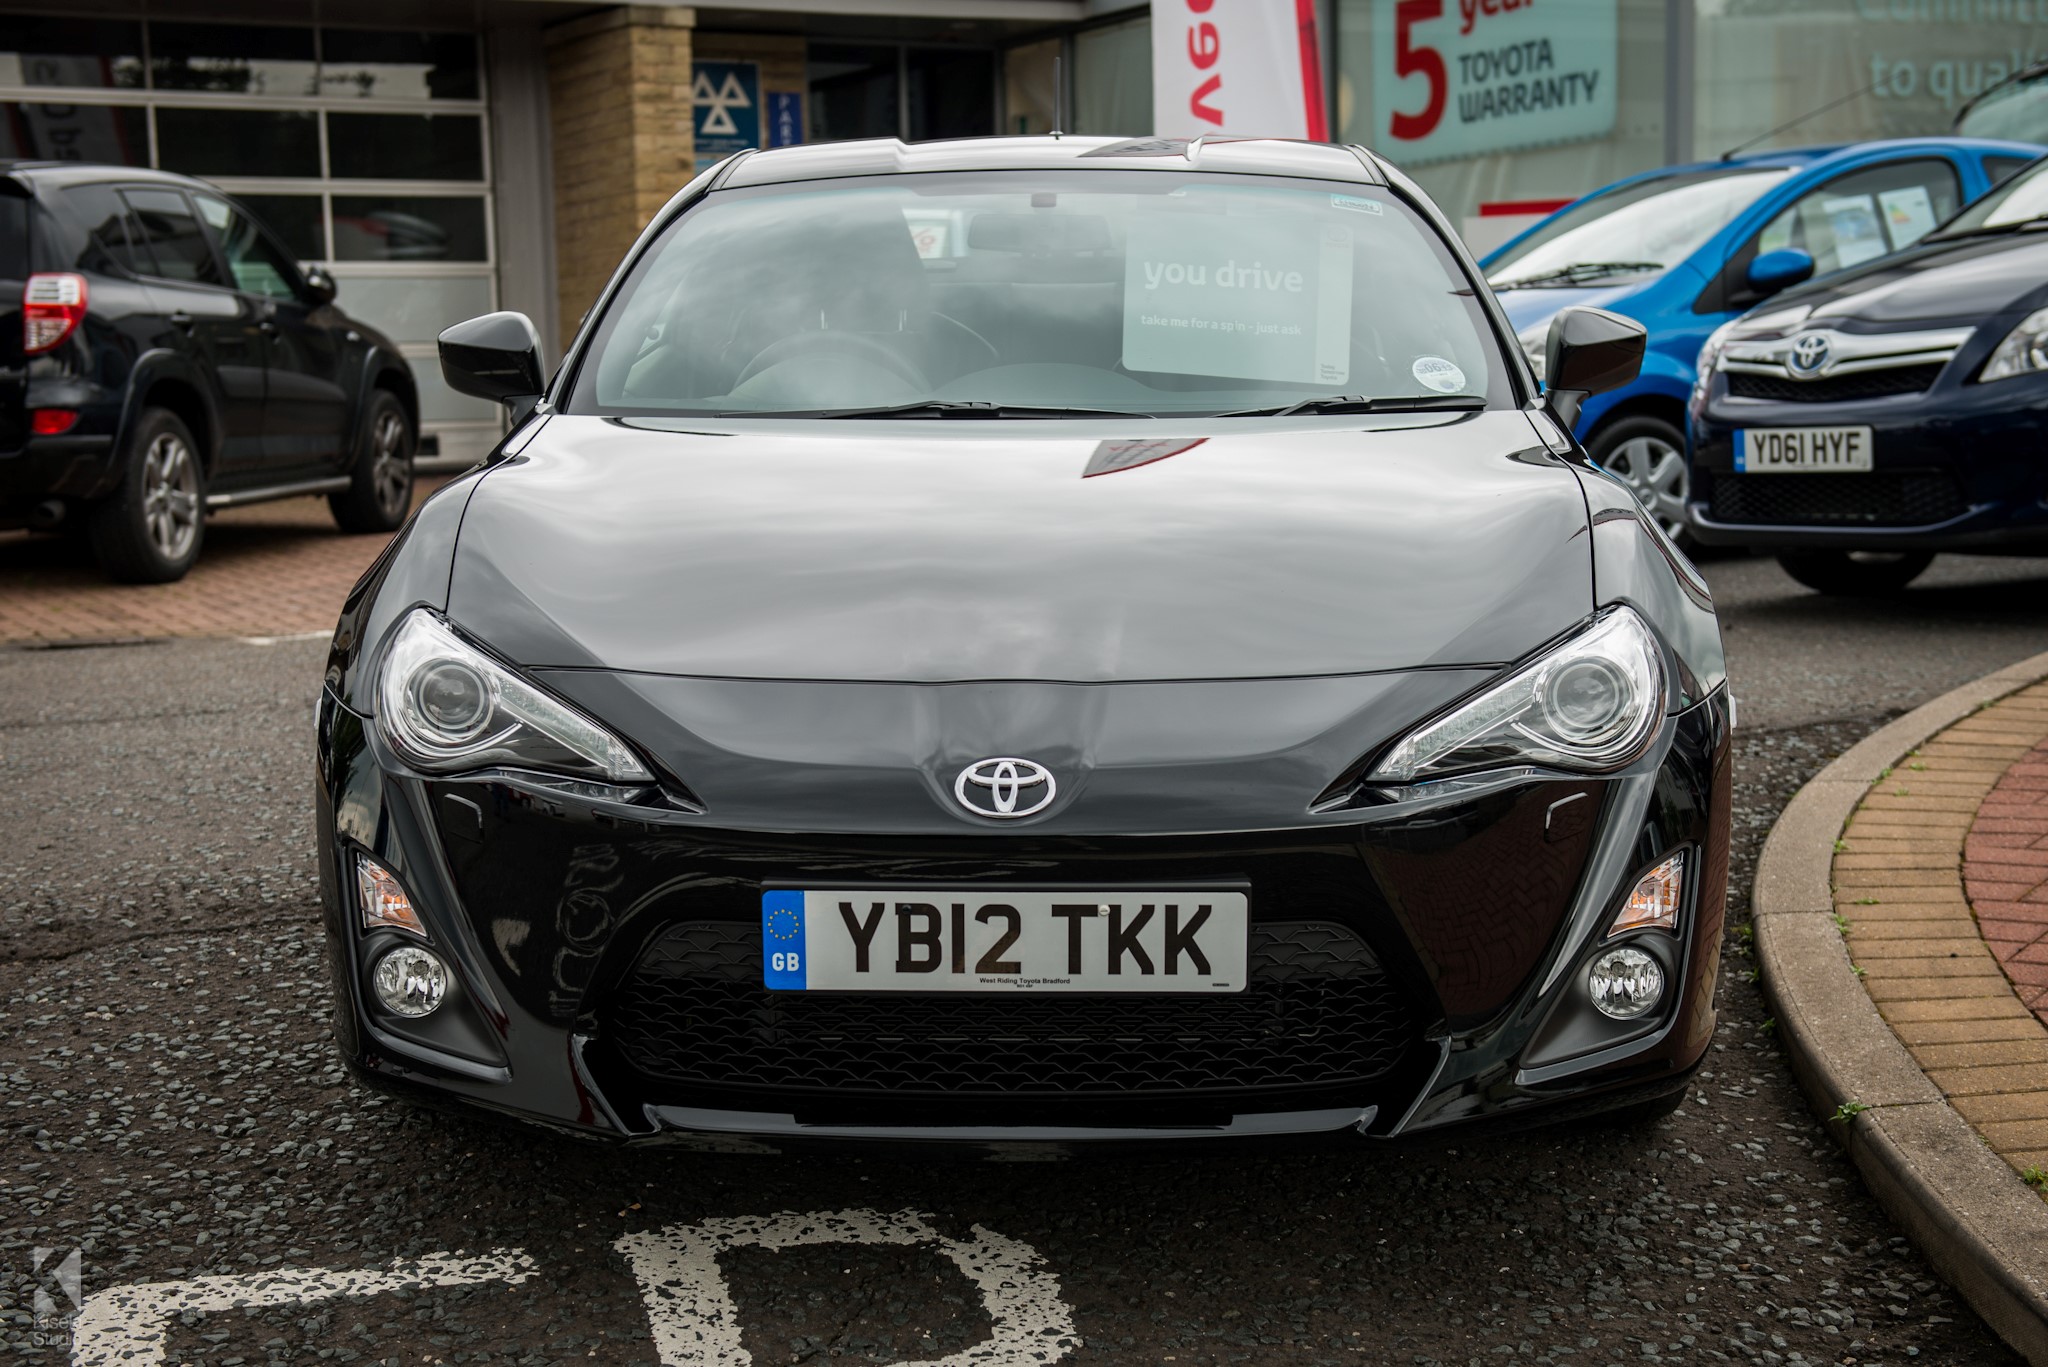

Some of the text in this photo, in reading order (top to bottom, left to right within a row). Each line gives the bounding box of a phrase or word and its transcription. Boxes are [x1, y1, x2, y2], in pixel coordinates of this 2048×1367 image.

[1459, 0, 1534, 36] ye
[1388, 0, 1448, 141] 5
[1458, 38, 1554, 84] TOYOTA
[1871, 51, 1917, 98] to
[1459, 70, 1599, 123] WARRANTY
[1144, 259, 1304, 292] you drive
[1141, 315, 1168, 326] take
[1170, 318, 1188, 328] me
[1191, 317, 1209, 329] for
[1211, 321, 1218, 330] a
[1220, 320, 1246, 333] spin
[1255, 321, 1279, 335] just
[1281, 324, 1302, 335] ask
[1753, 432, 1861, 464] YD61 HYF
[838, 901, 1212, 975] YB12 TKK
[772, 952, 799, 971] GB
[997, 977, 1018, 985] Riding
[1019, 977, 1041, 985] Toyota
